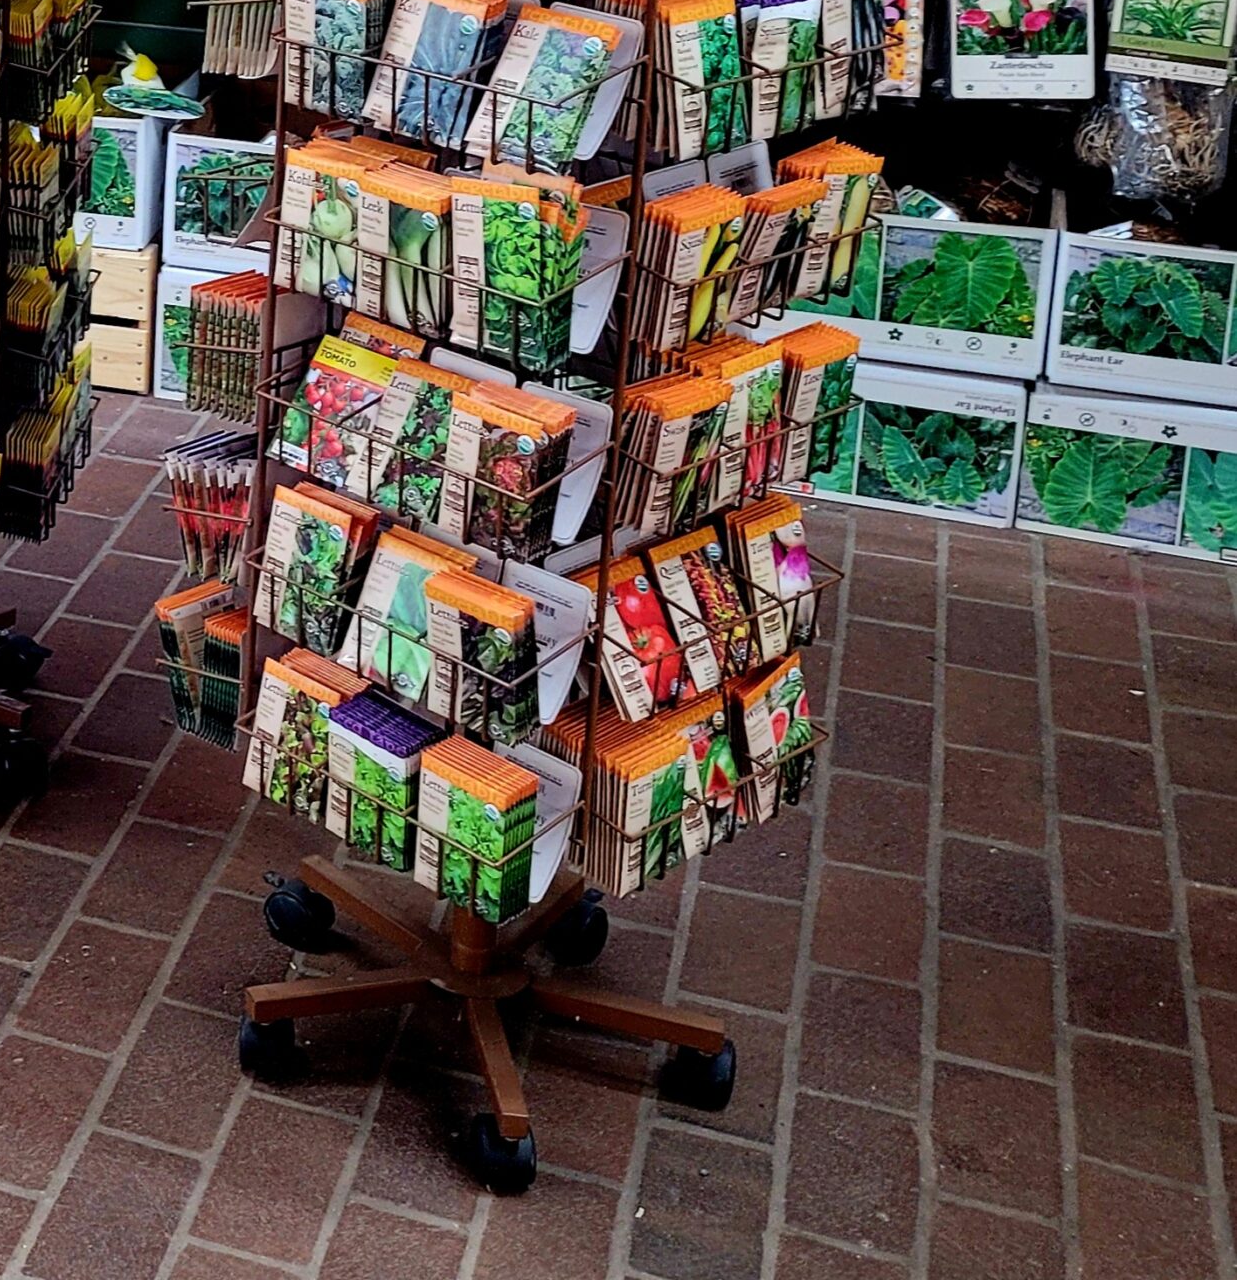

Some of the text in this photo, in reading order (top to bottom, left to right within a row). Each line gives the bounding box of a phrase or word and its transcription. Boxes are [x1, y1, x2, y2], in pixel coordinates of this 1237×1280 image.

[515, 23, 539, 41] Kale
[989, 60, 1055, 70] Zantedeschia
[361, 196, 384, 214] Leek
[319, 349, 357, 369] TOMATO
[1060, 350, 1124, 366] Elephant Ear
[954, 401, 1017, 417] Elephant Ear
